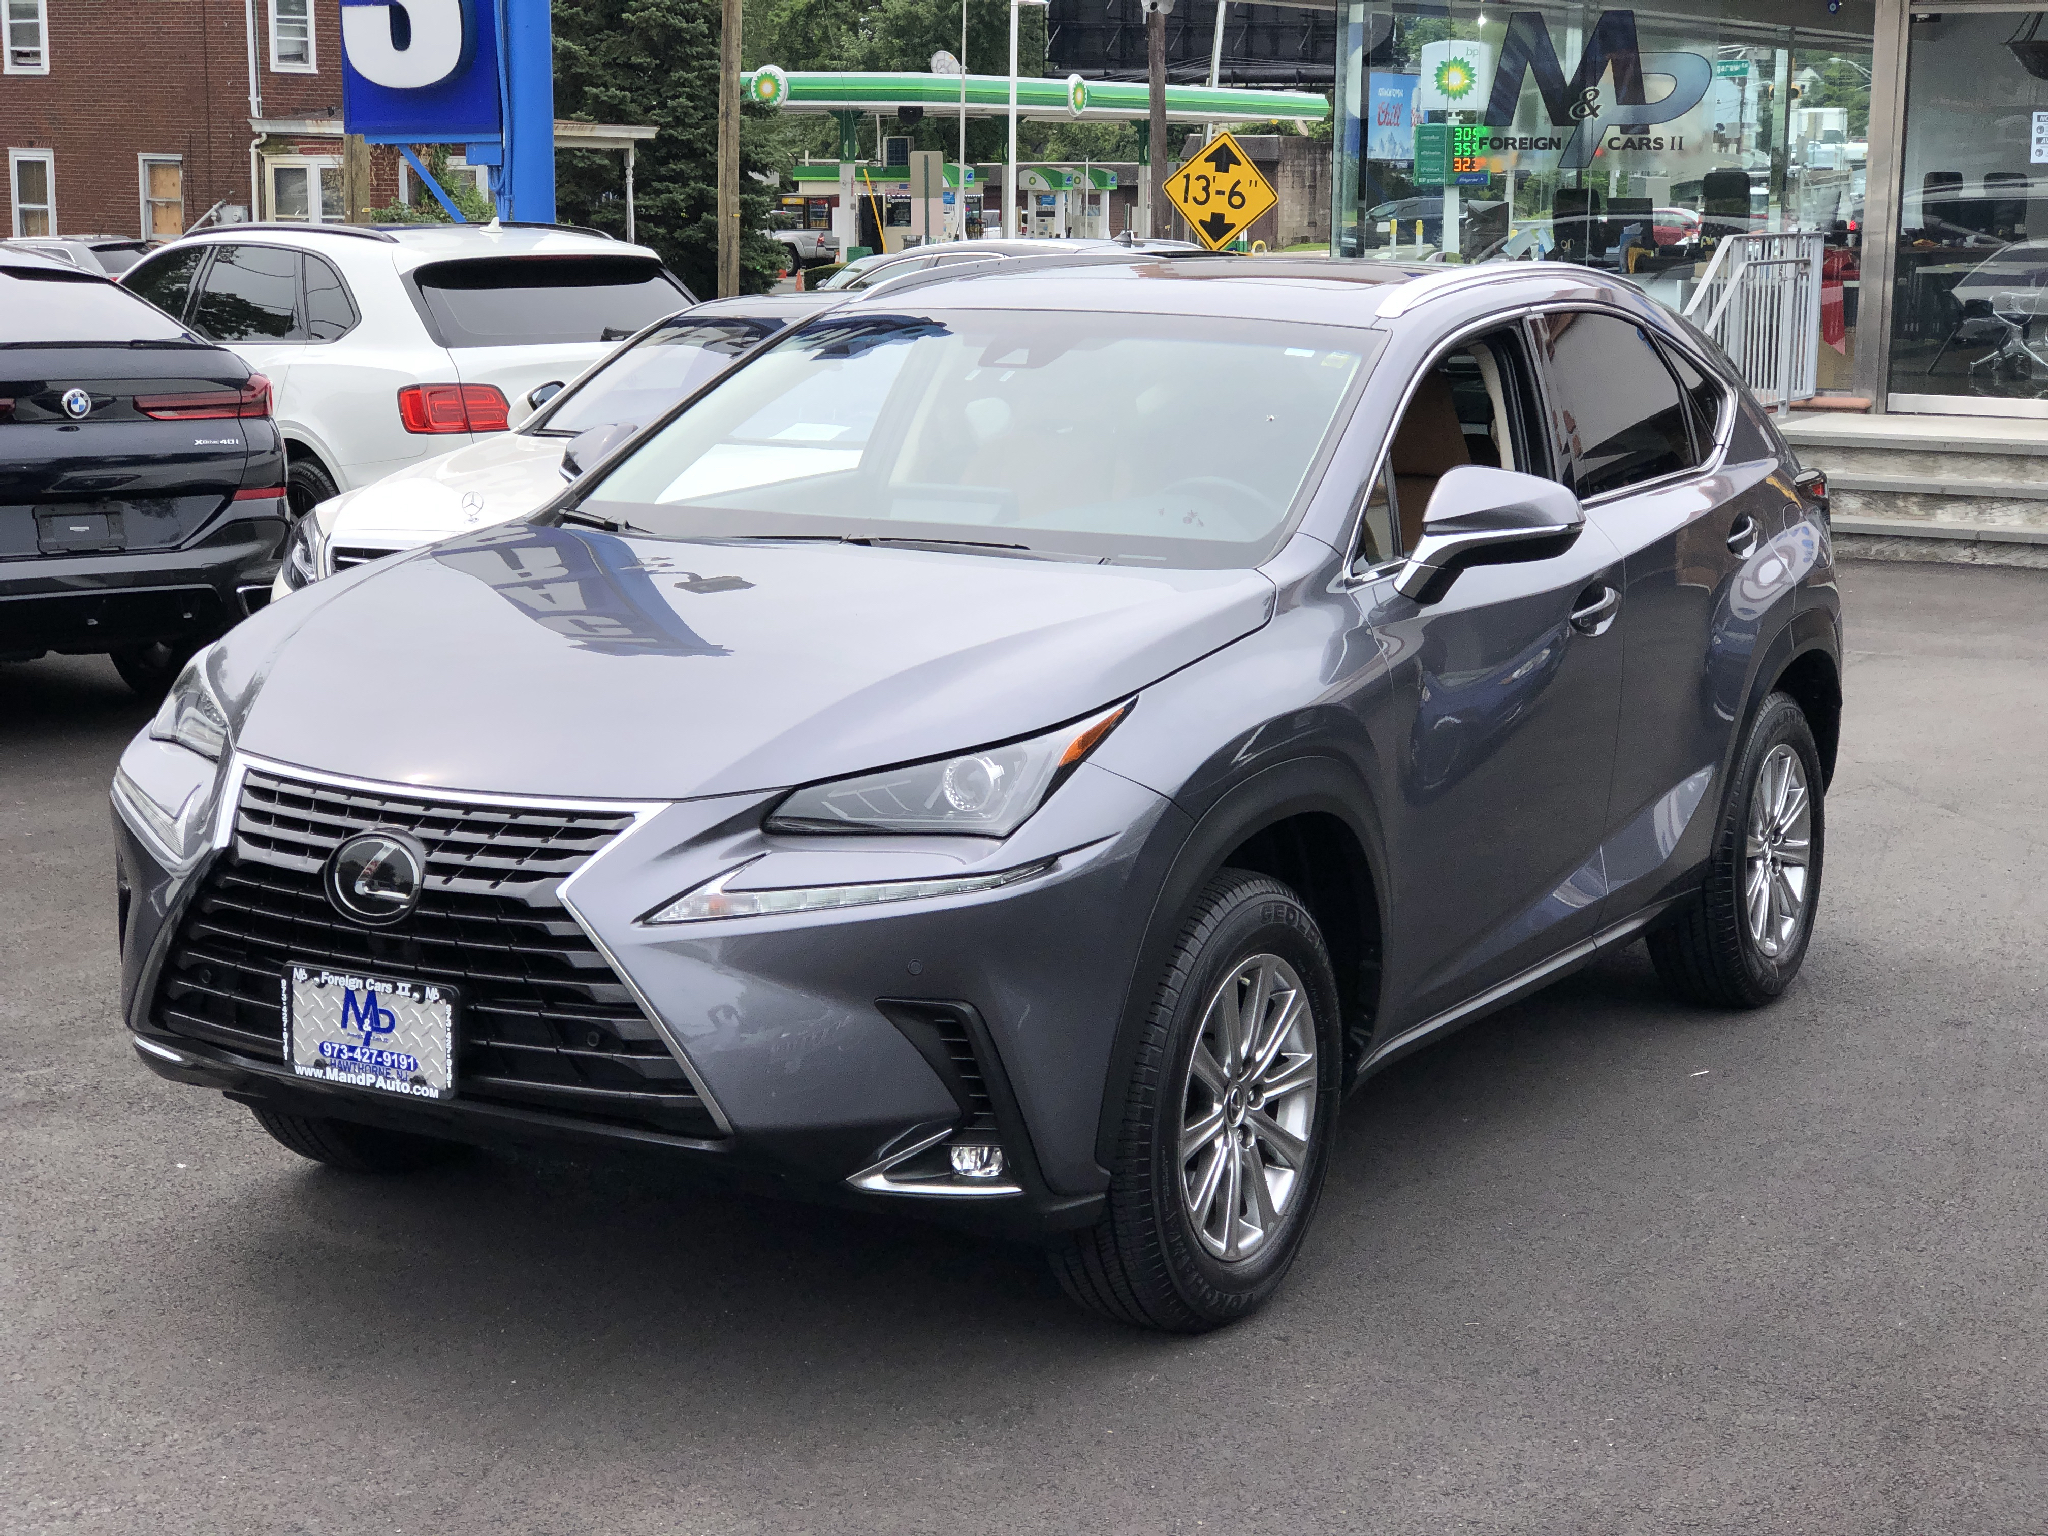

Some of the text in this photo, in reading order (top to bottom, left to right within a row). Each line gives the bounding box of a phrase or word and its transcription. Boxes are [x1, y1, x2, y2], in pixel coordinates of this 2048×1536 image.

[1466, 46, 1479, 57] bp
[1479, 136, 1684, 151] FOREIGN CARS II
[321, 971, 411, 996] Foreign Cars II
[323, 1042, 414, 1071] 973-427-9191
[294, 1064, 439, 1099] www.MandPAuto.com
